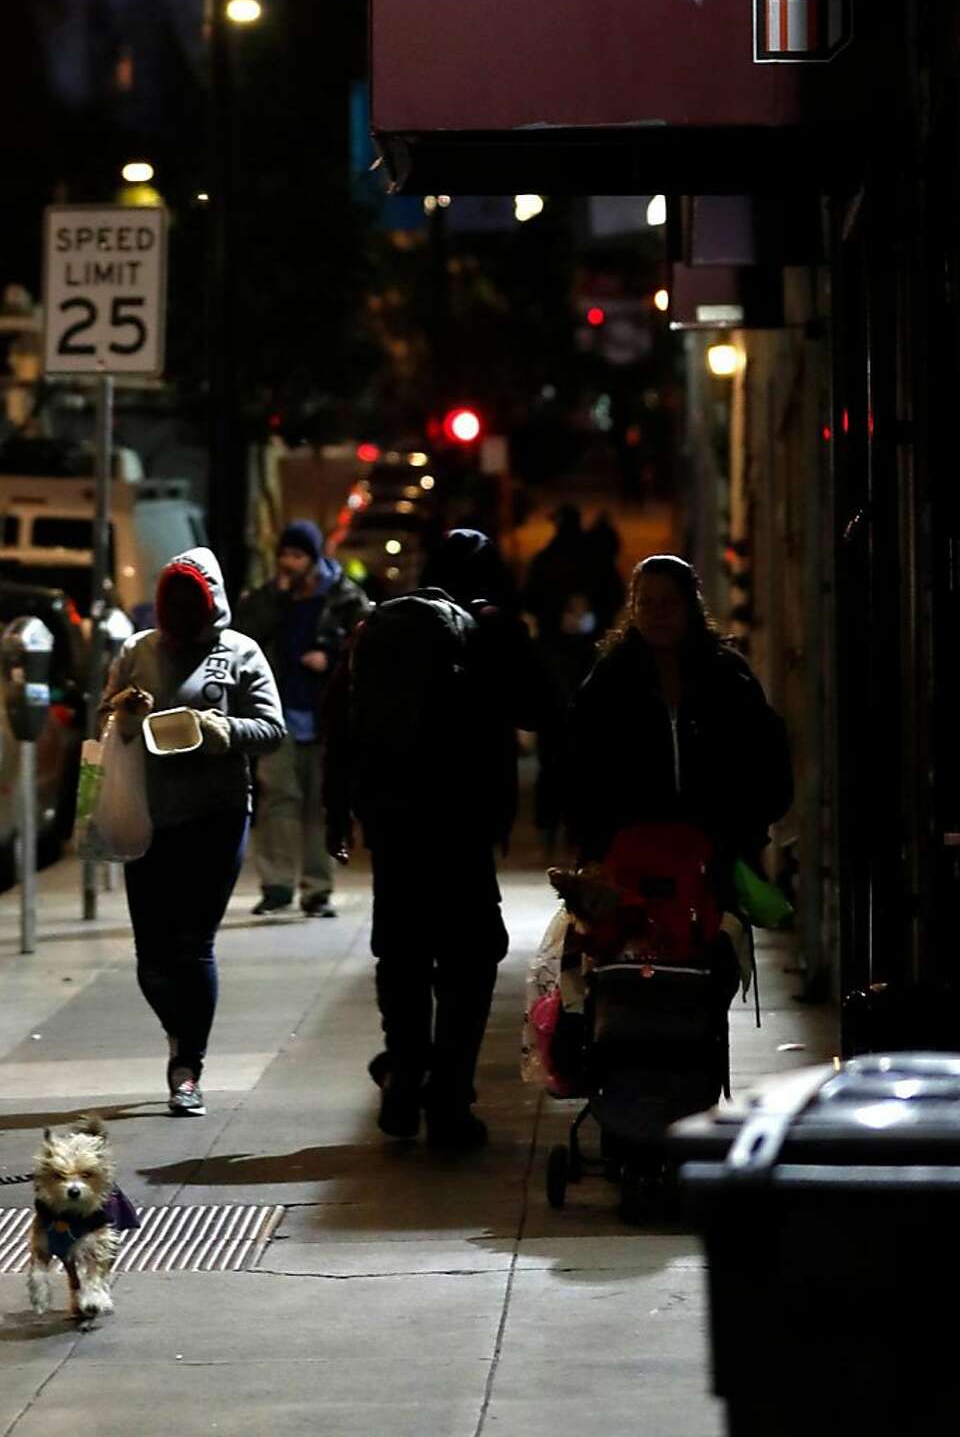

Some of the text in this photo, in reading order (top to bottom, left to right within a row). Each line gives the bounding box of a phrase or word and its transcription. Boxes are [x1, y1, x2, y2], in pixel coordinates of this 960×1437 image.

[55, 226, 155, 252] SPEED
[64, 260, 140, 287] LIMIT
[57, 296, 148, 356] 25
[202, 643, 232, 704] AERO
